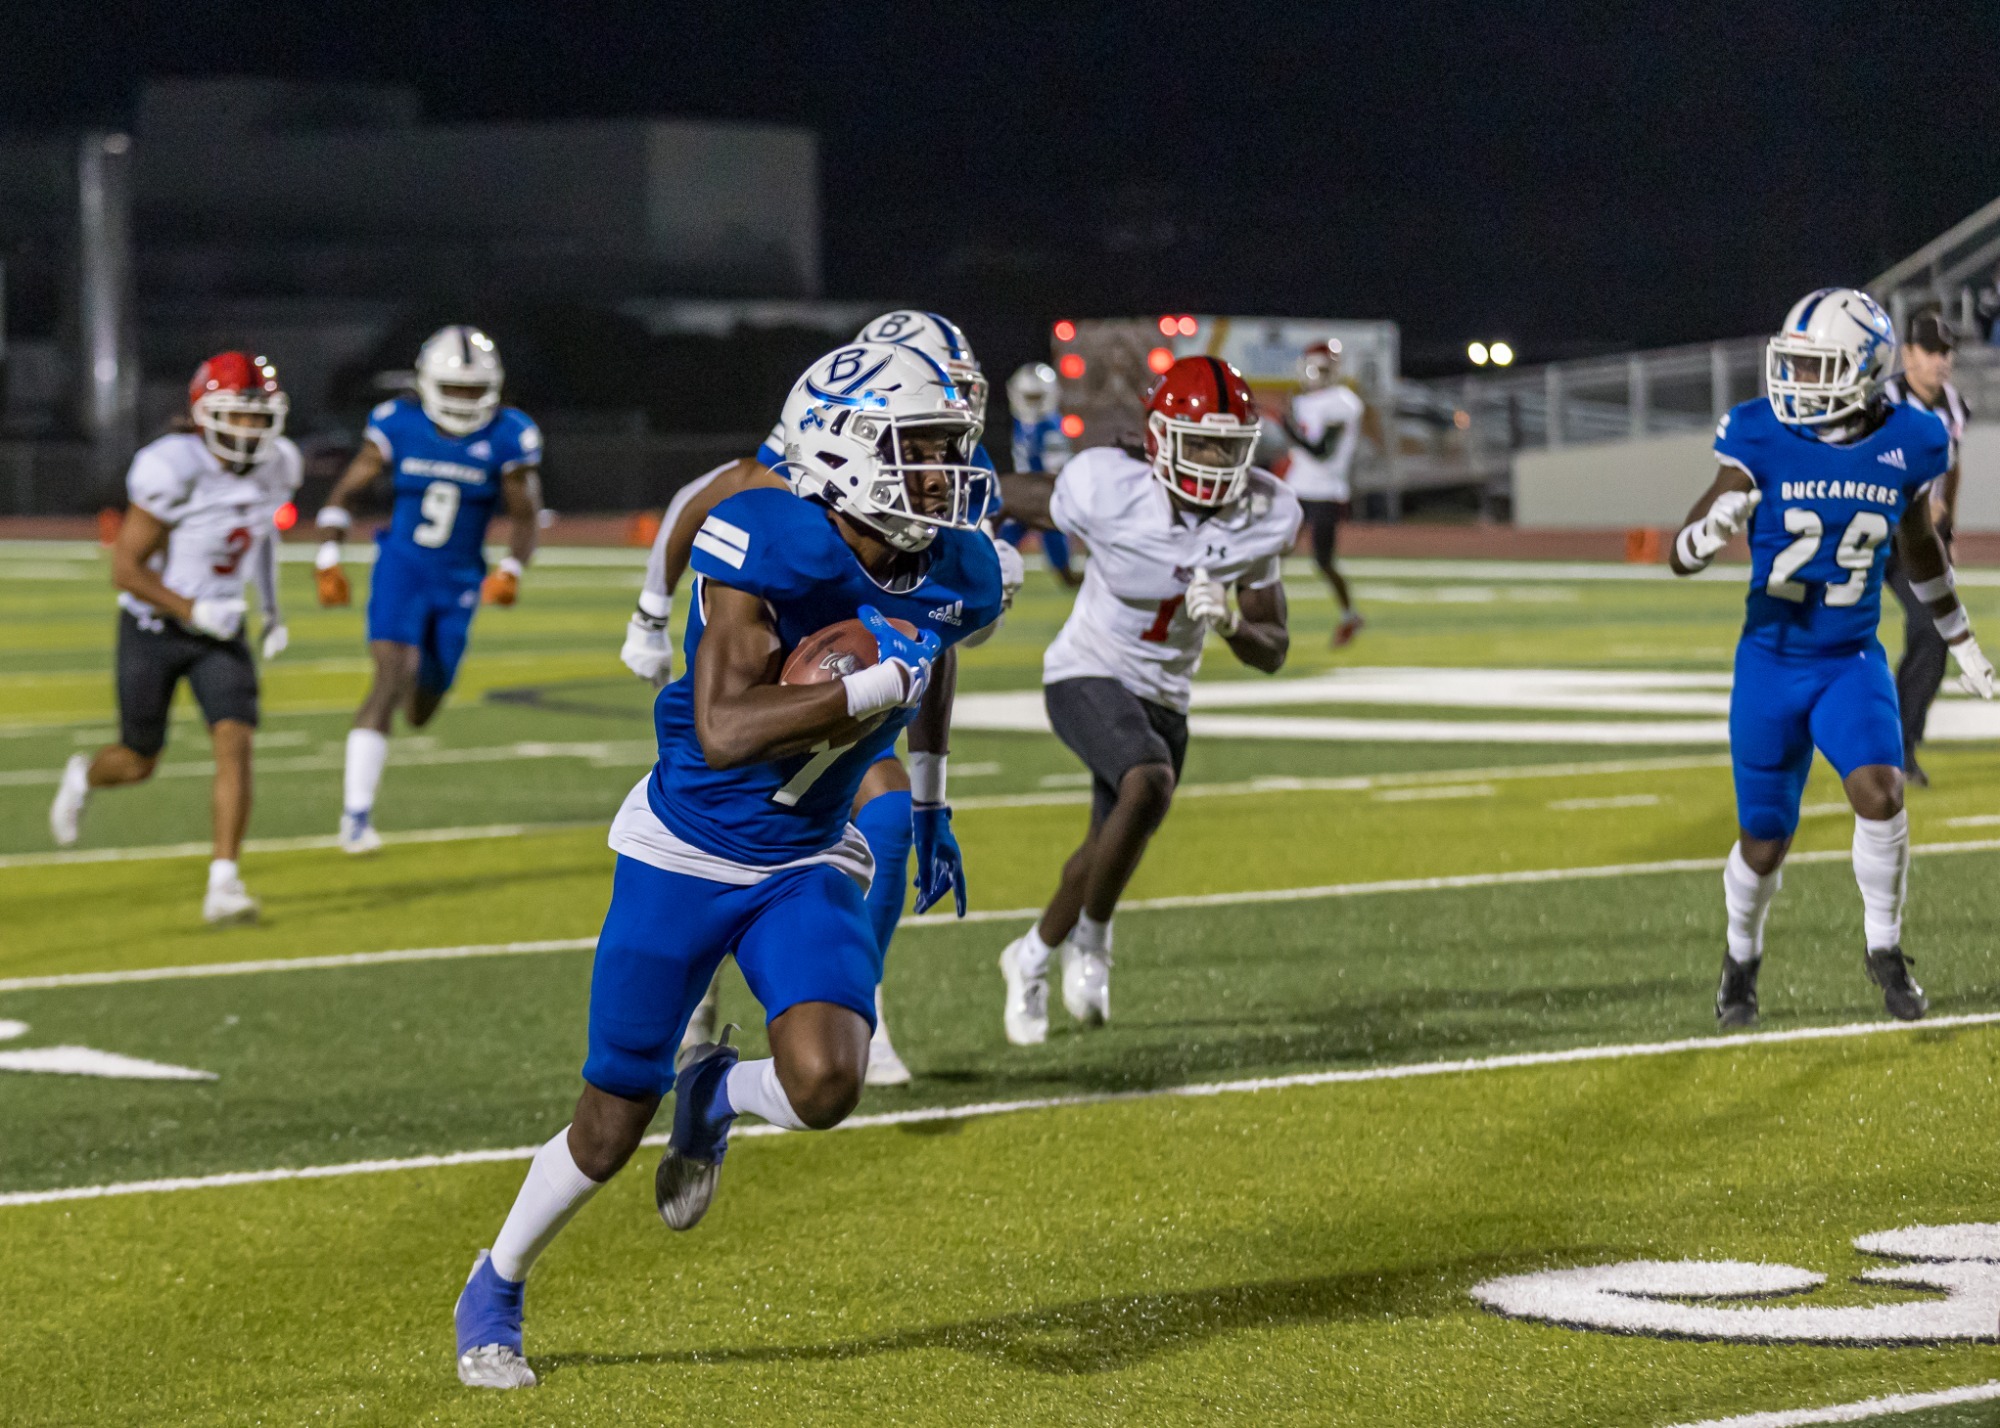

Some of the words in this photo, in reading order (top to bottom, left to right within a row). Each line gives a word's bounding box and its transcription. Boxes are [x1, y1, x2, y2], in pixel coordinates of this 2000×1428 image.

[877, 313, 912, 338] B
[824, 348, 868, 387] B
[1781, 479, 1899, 507] BUCCANEERS
[412, 479, 461, 549] 9
[211, 526, 253, 578] 3
[1765, 506, 1889, 608] 29
[928, 610, 963, 627] adidas
